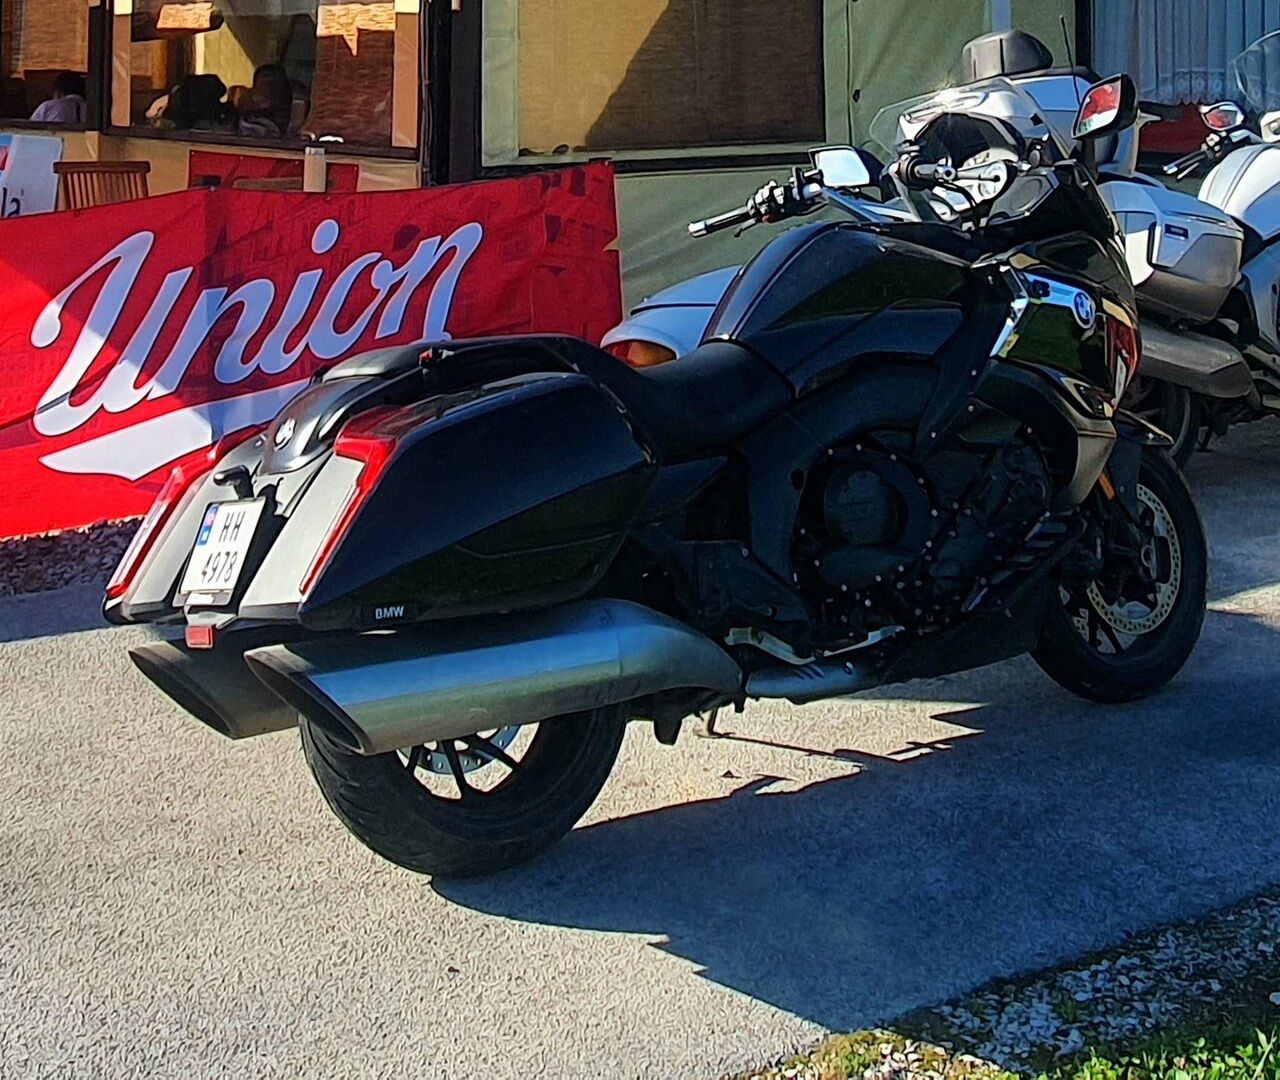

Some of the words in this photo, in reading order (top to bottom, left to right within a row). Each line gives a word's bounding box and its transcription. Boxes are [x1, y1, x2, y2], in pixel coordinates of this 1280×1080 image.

[31, 219, 483, 437] Union
[218, 510, 246, 543] HH
[200, 550, 238, 584] 4978
[375, 605, 405, 620] BMW
